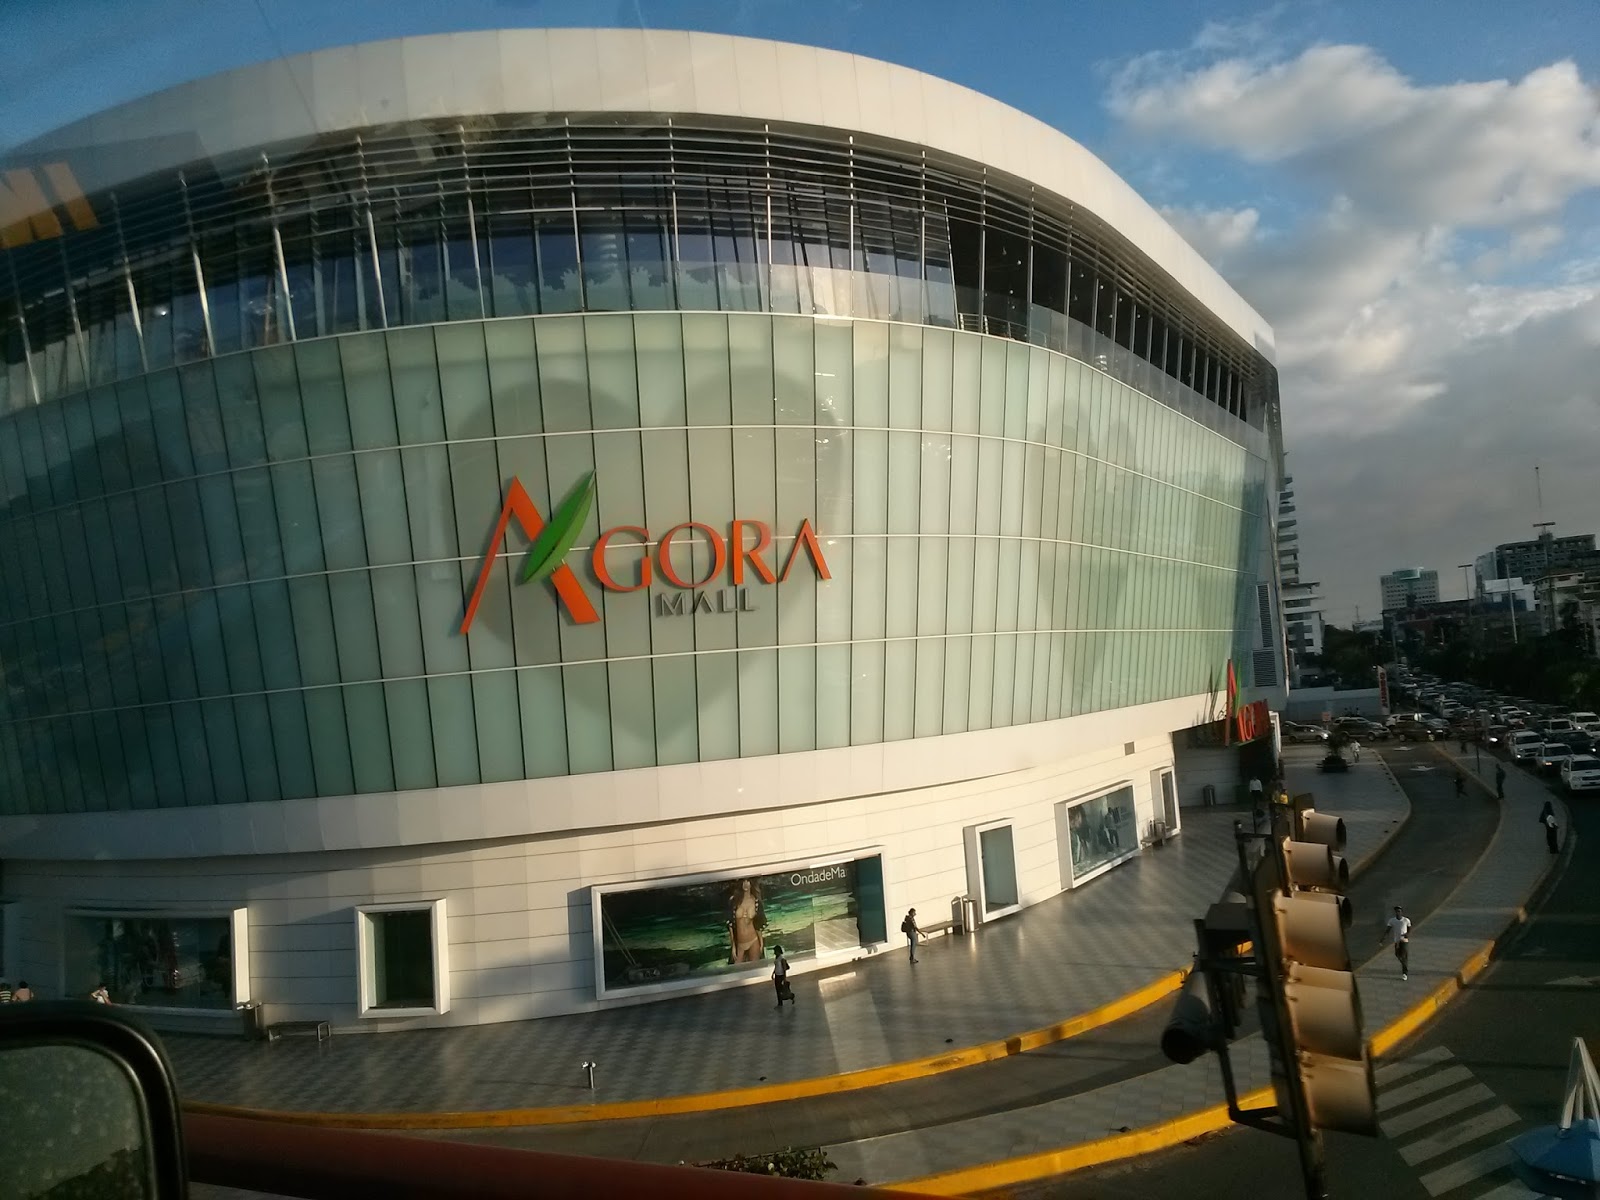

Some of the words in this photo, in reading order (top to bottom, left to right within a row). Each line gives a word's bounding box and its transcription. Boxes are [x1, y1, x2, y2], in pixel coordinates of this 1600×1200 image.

[460, 470, 832, 635] AGORA
[658, 588, 756, 616] MALL
[790, 866, 848, 886] OndadeMa
